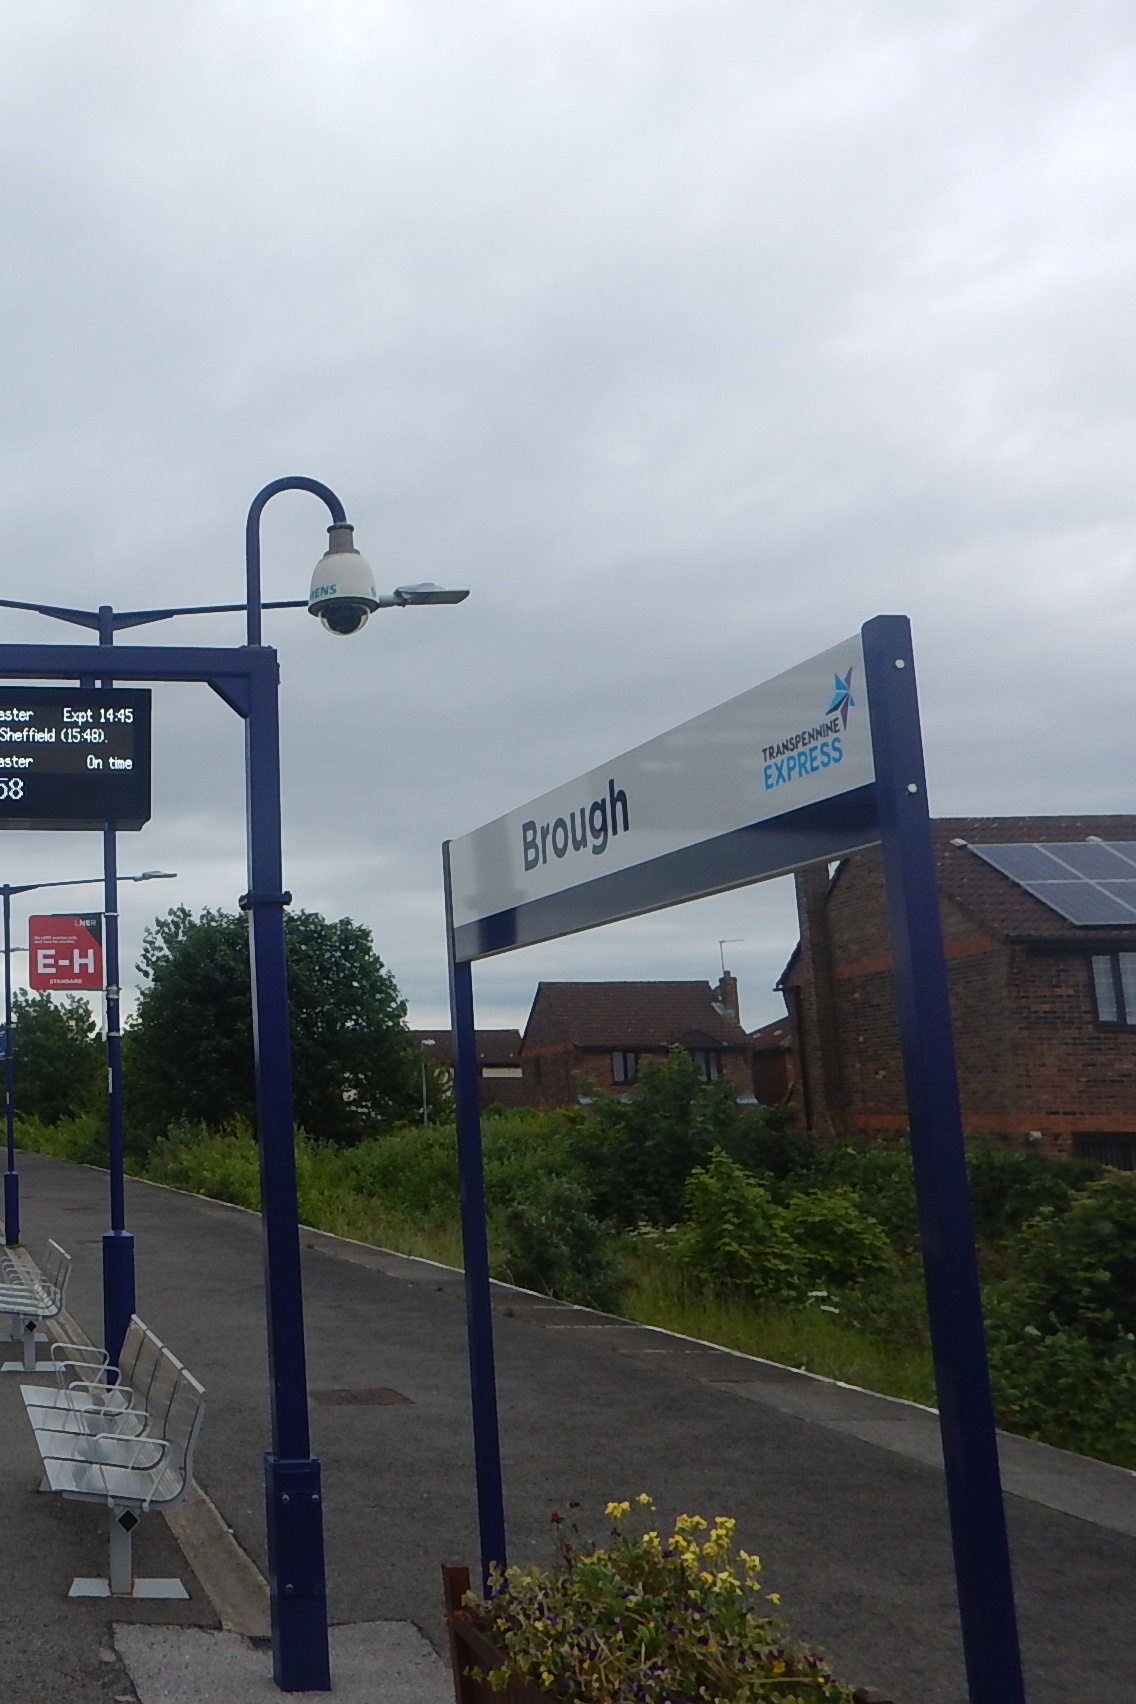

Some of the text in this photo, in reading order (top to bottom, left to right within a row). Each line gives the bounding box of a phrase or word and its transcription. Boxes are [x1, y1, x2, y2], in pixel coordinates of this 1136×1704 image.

[63, 707, 93, 726] Expt
[99, 708, 134, 723] 14:45
[0, 727, 56, 743] Sheffield
[60, 728, 109, 743] (15:48).
[762, 717, 840, 763] TRANSPENNINE
[86, 755, 103, 769] On
[108, 756, 133, 770] time
[763, 737, 843, 791] EXPRESS
[521, 778, 630, 872] Brough
[74, 918, 97, 927] LNER
[36, 948, 95, 974] E-H
